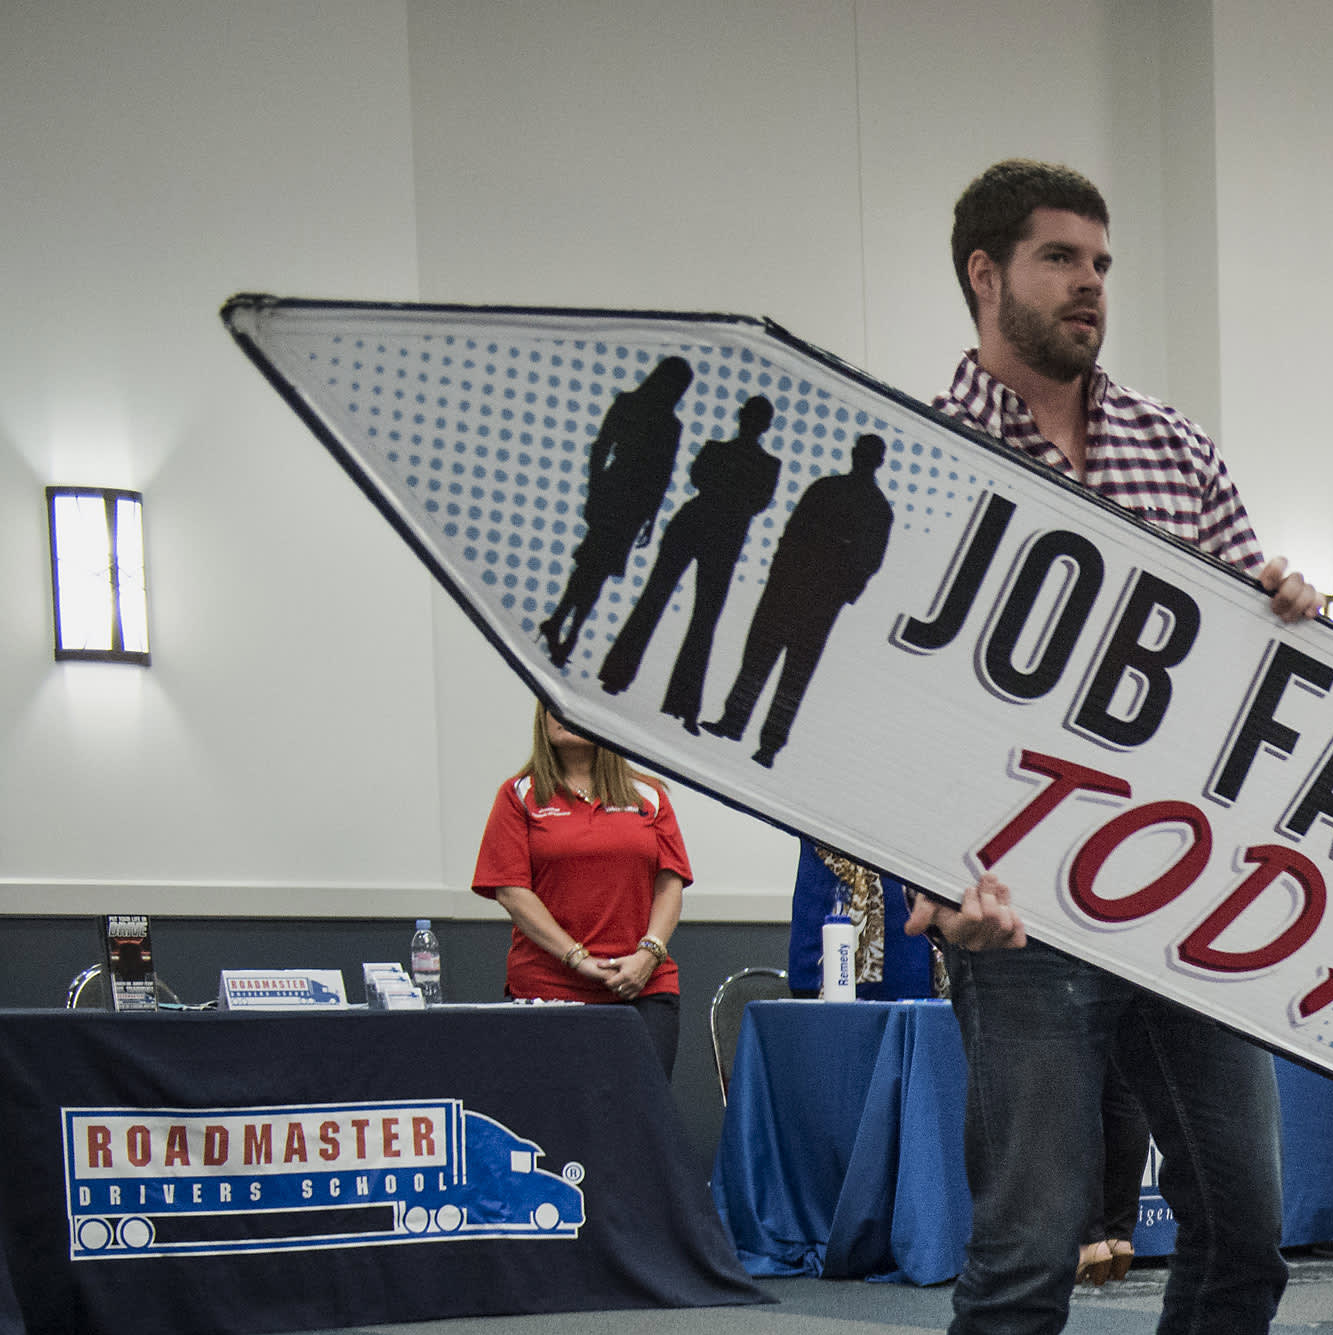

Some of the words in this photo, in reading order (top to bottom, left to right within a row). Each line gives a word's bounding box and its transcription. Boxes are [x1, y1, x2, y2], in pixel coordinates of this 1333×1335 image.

[891, 490, 1202, 752] JOB
[230, 979, 306, 990] ROADMASTER
[838, 943, 850, 987] Remedy
[87, 1116, 436, 1168] ROADMASTER
[79, 1181, 262, 1206] DRIVERS
[301, 1173, 448, 1200] SCHOOL
